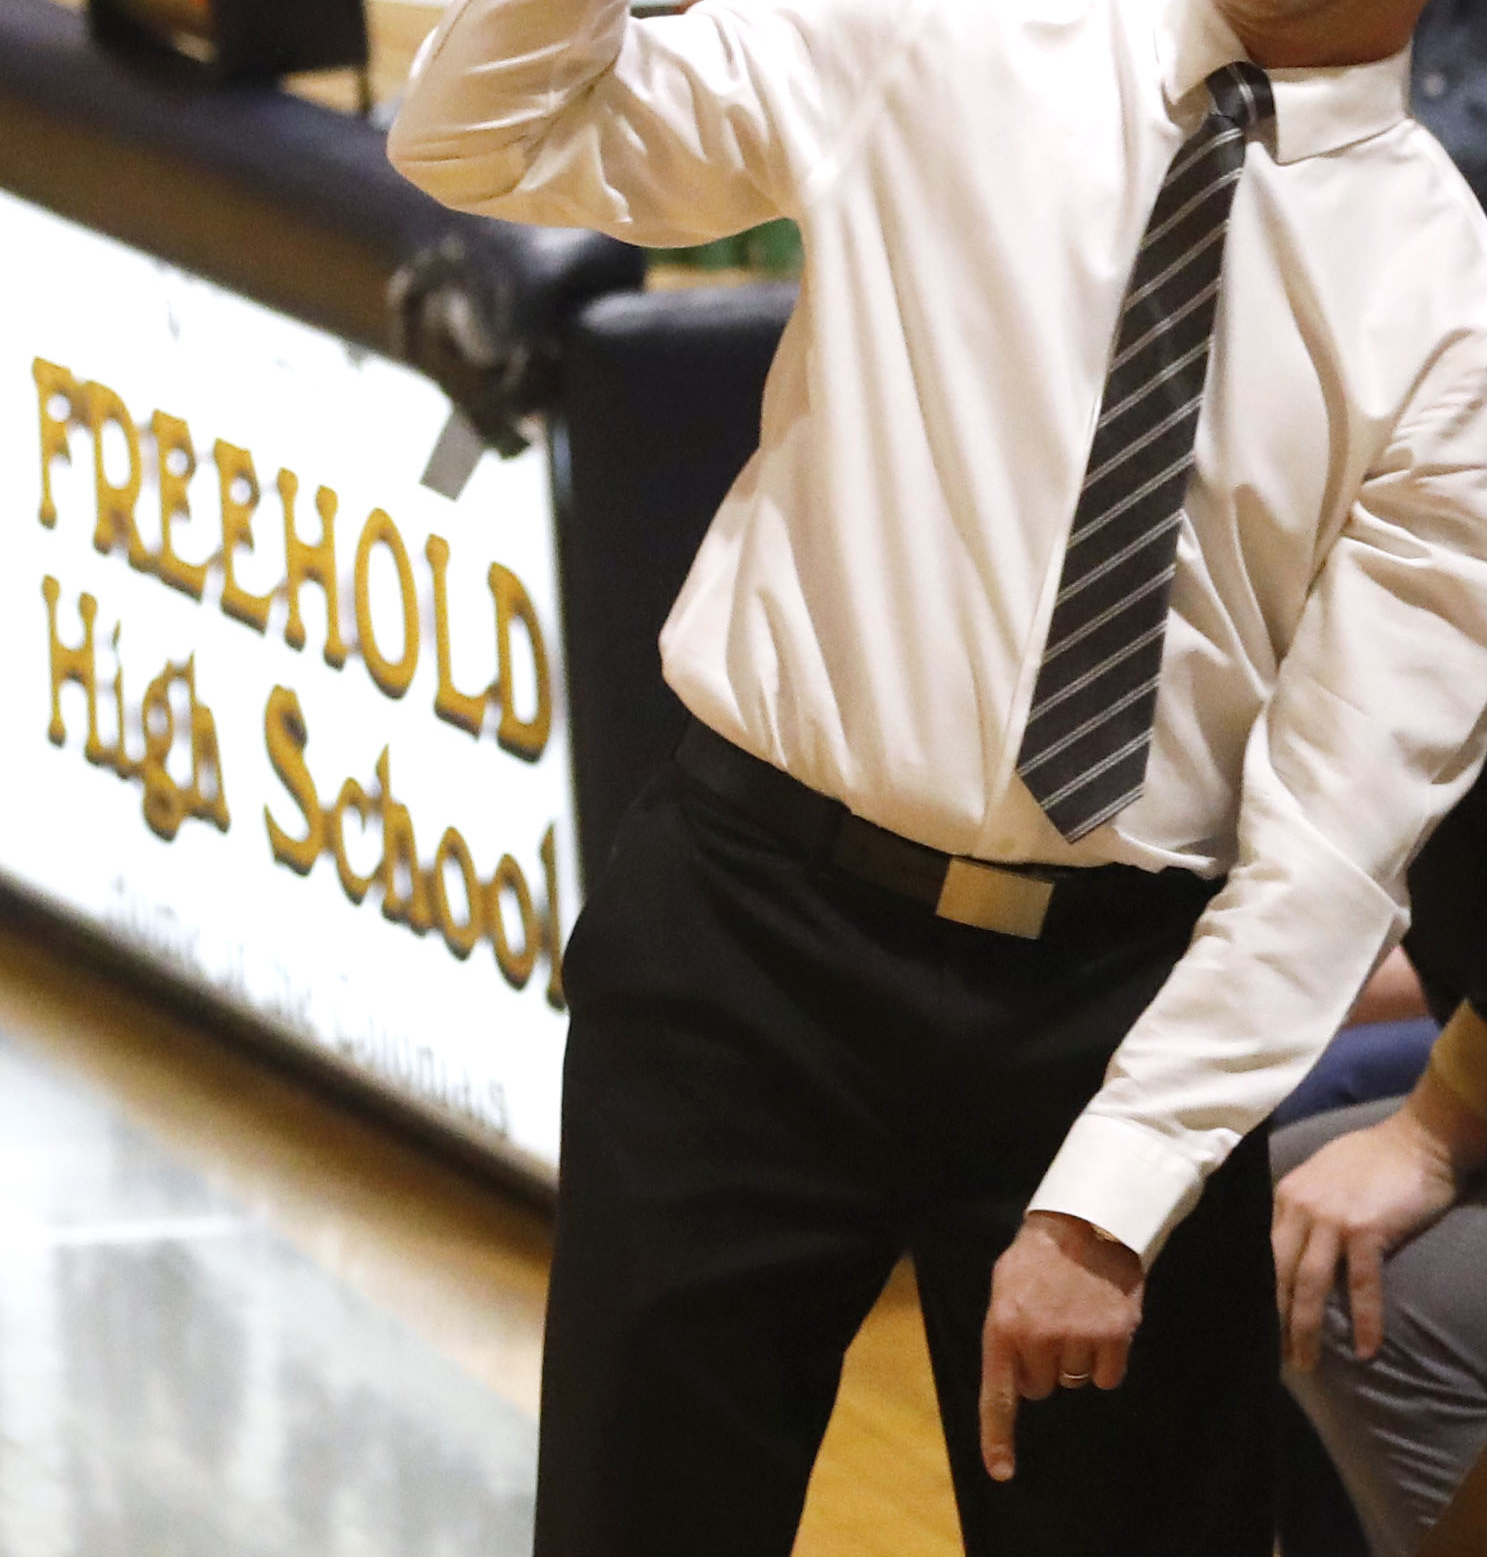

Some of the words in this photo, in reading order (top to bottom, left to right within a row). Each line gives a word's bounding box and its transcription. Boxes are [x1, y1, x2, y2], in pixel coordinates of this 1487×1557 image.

[32, 356, 553, 765] FREEHOLD
[41, 573, 232, 843] High
[263, 683, 568, 1013] School
